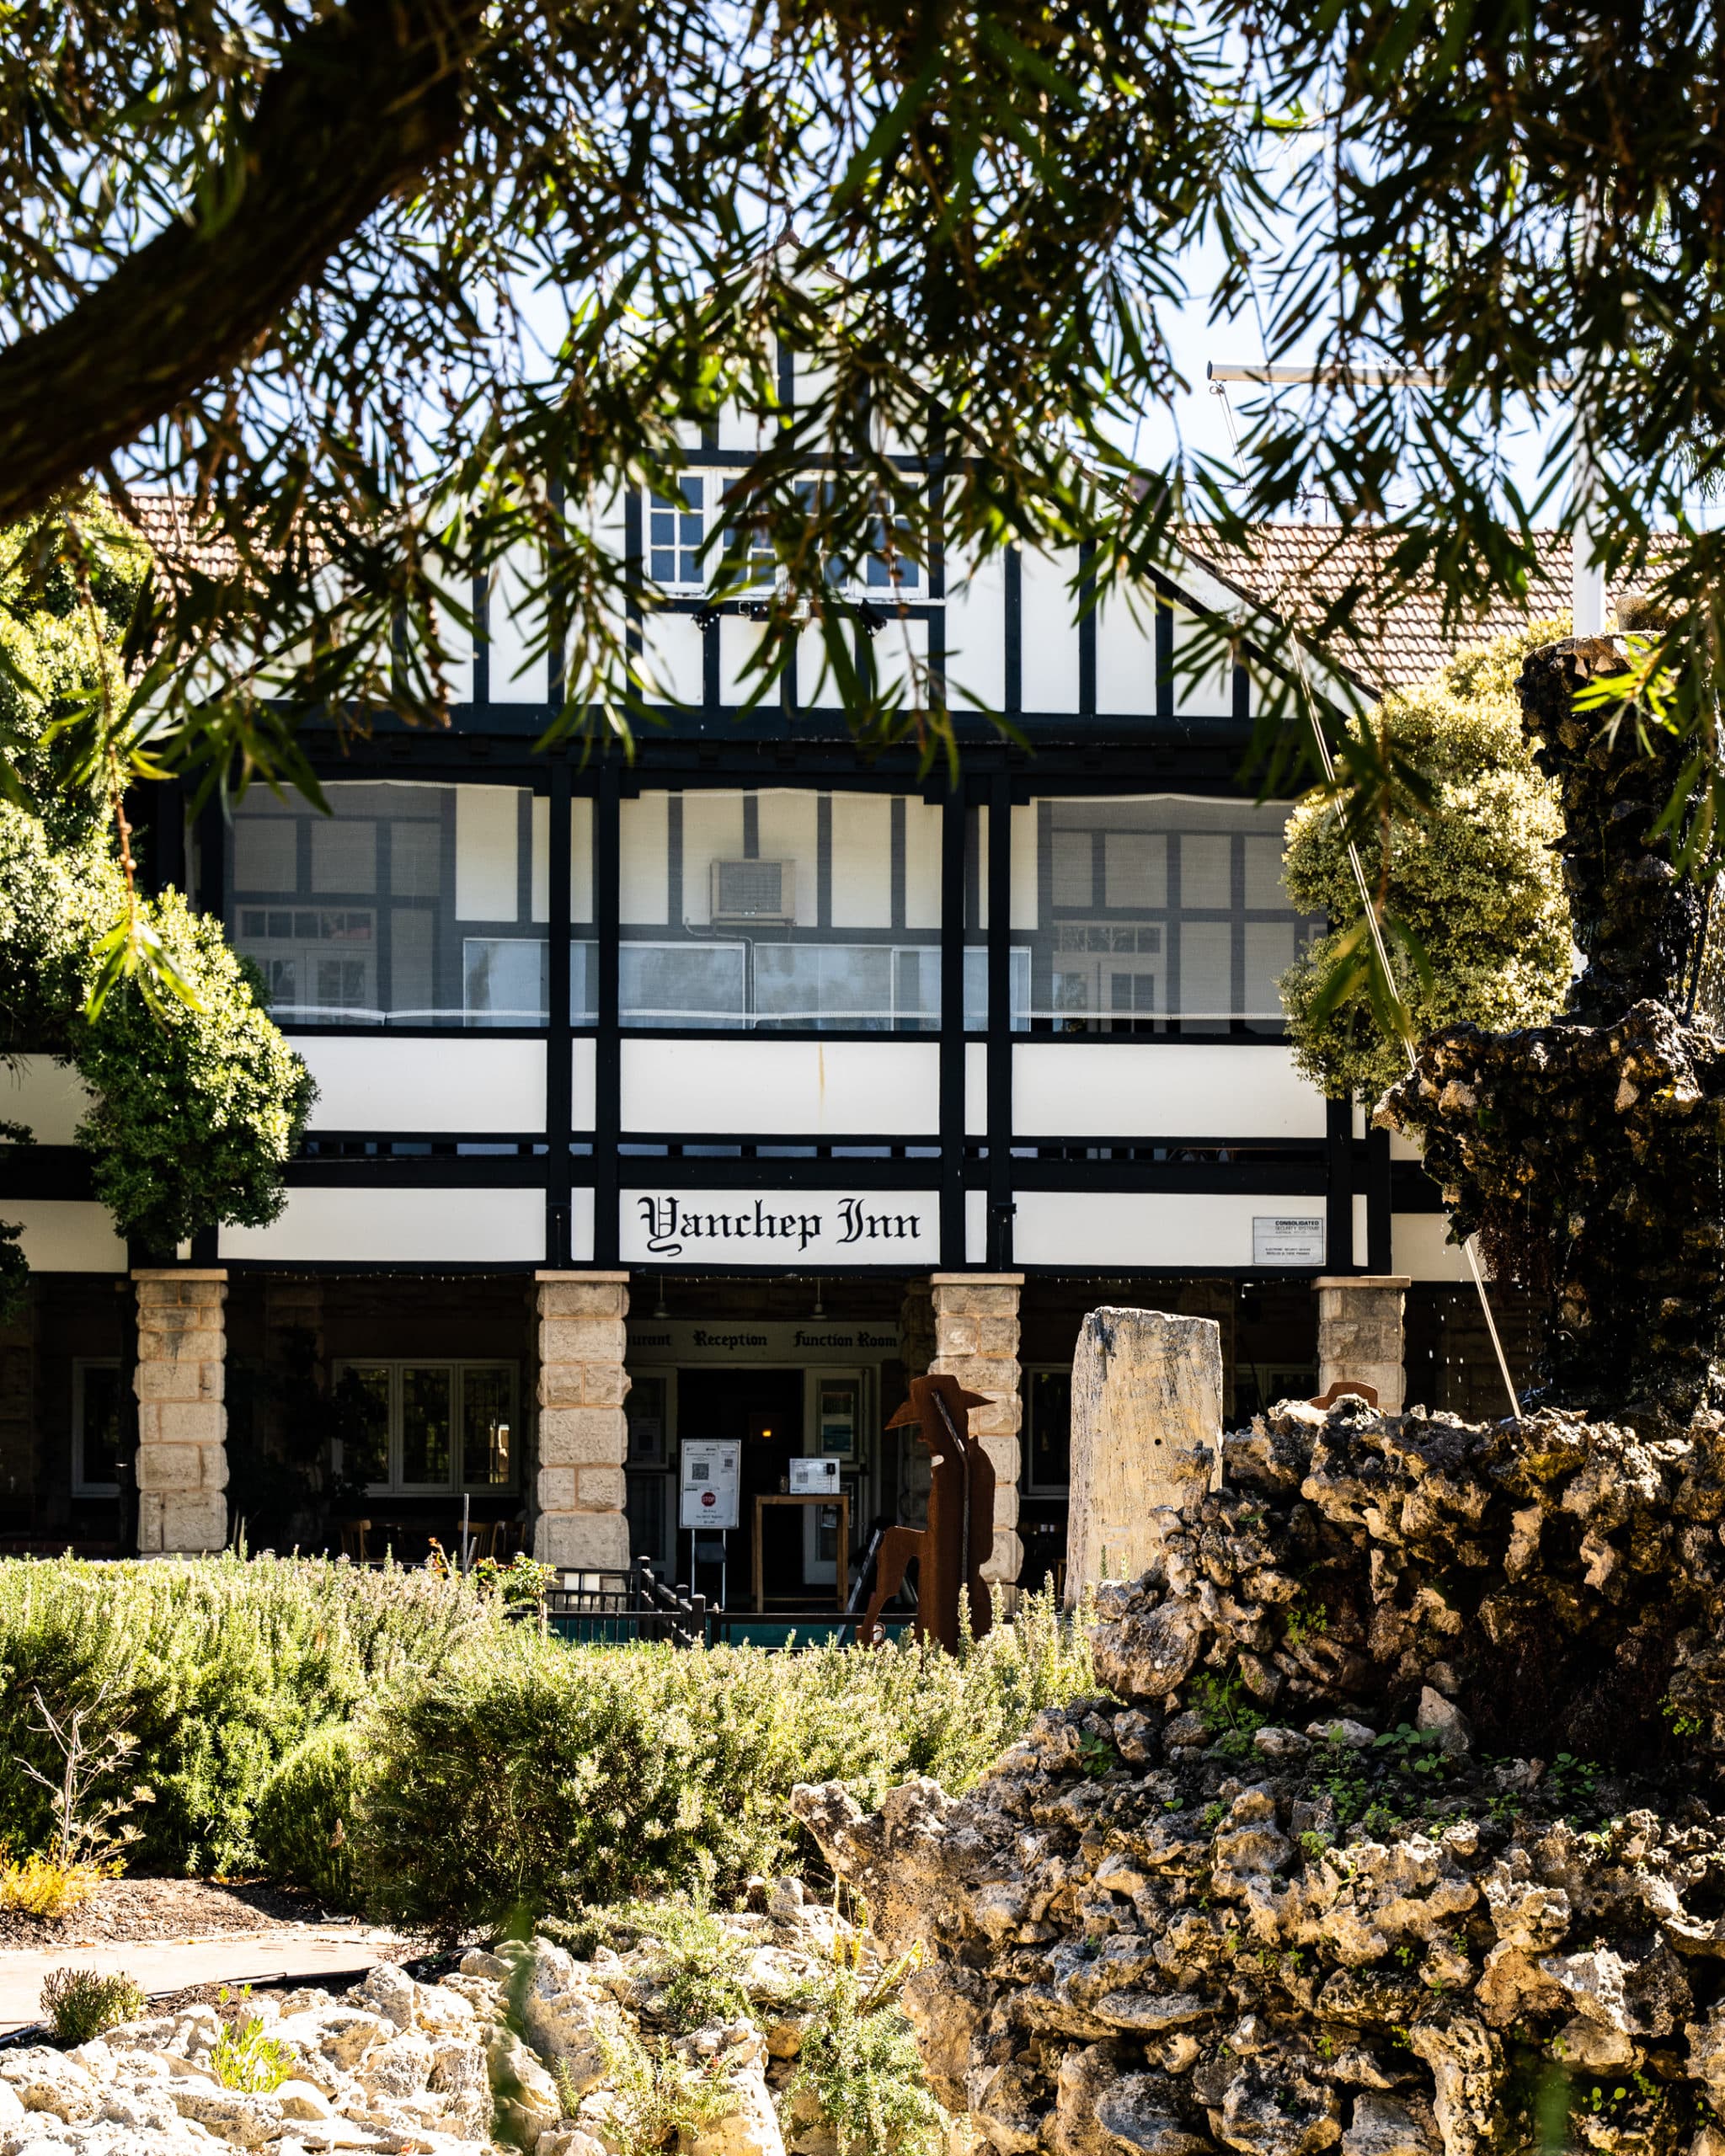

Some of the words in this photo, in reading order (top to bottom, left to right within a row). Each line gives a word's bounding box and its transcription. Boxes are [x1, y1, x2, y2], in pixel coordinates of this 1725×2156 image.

[638, 1196, 823, 1257] Yanchep
[836, 1198, 921, 1244] Inn
[693, 1330, 768, 1350] Reception
[793, 1330, 852, 1347] Function
[857, 1331, 898, 1348] Room
